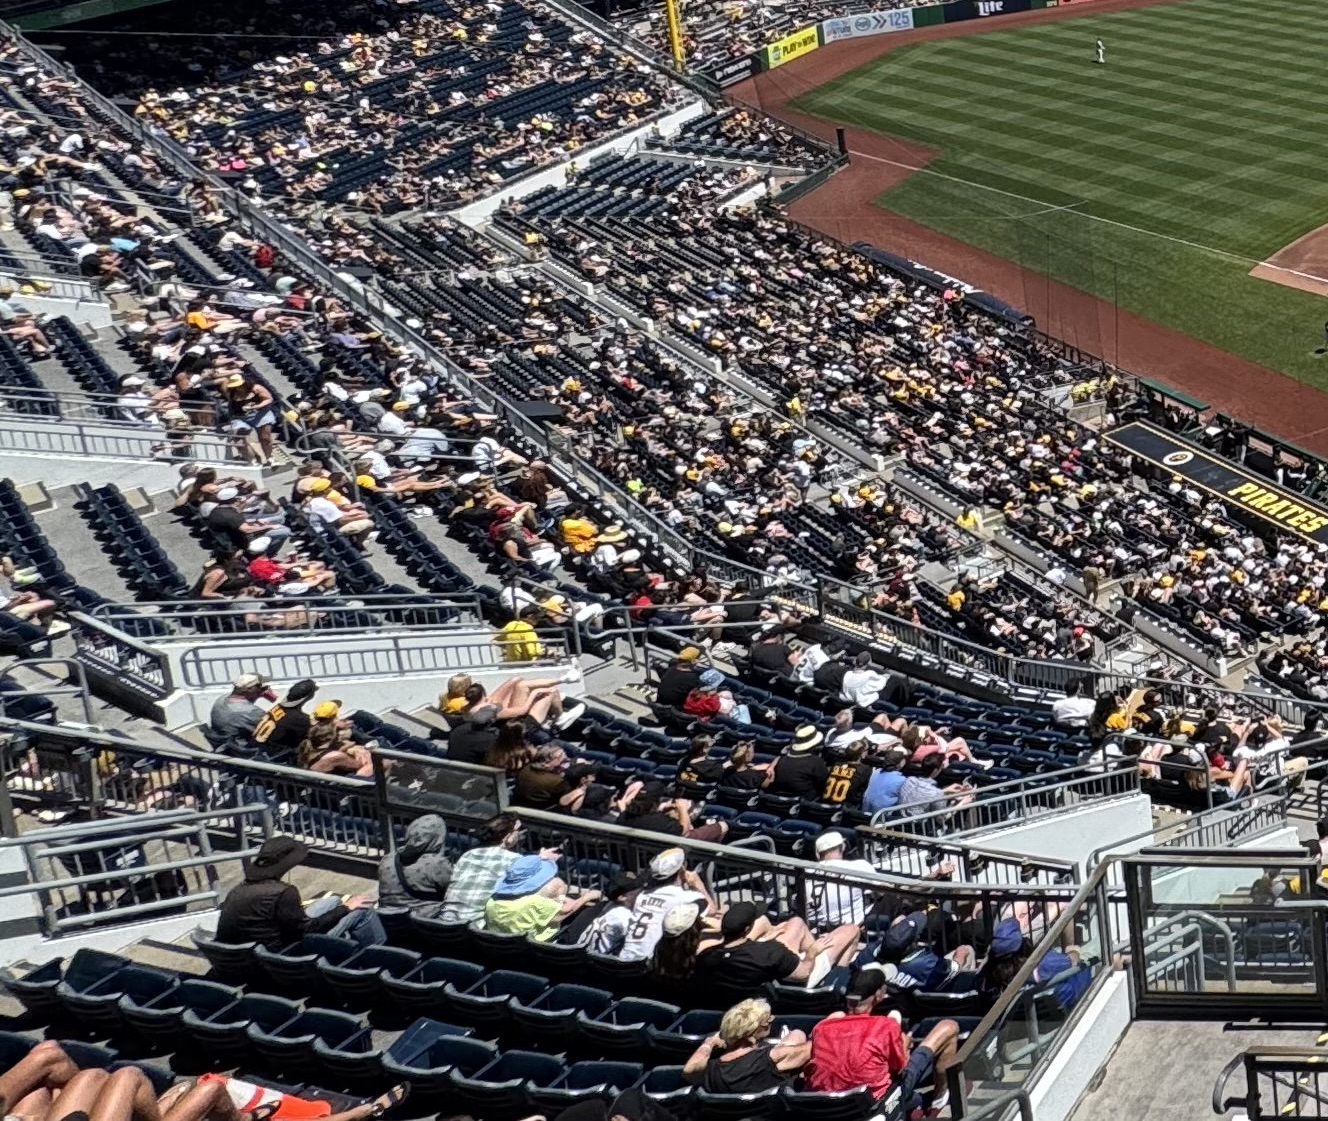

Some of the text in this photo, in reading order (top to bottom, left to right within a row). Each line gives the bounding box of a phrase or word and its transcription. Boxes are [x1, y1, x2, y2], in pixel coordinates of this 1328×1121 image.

[978, 1, 1003, 16] Lite
[888, 11, 910, 27] 125
[782, 44, 797, 56] PLAY
[1227, 482, 1328, 534] PIRATES
[629, 912, 654, 940] 6
